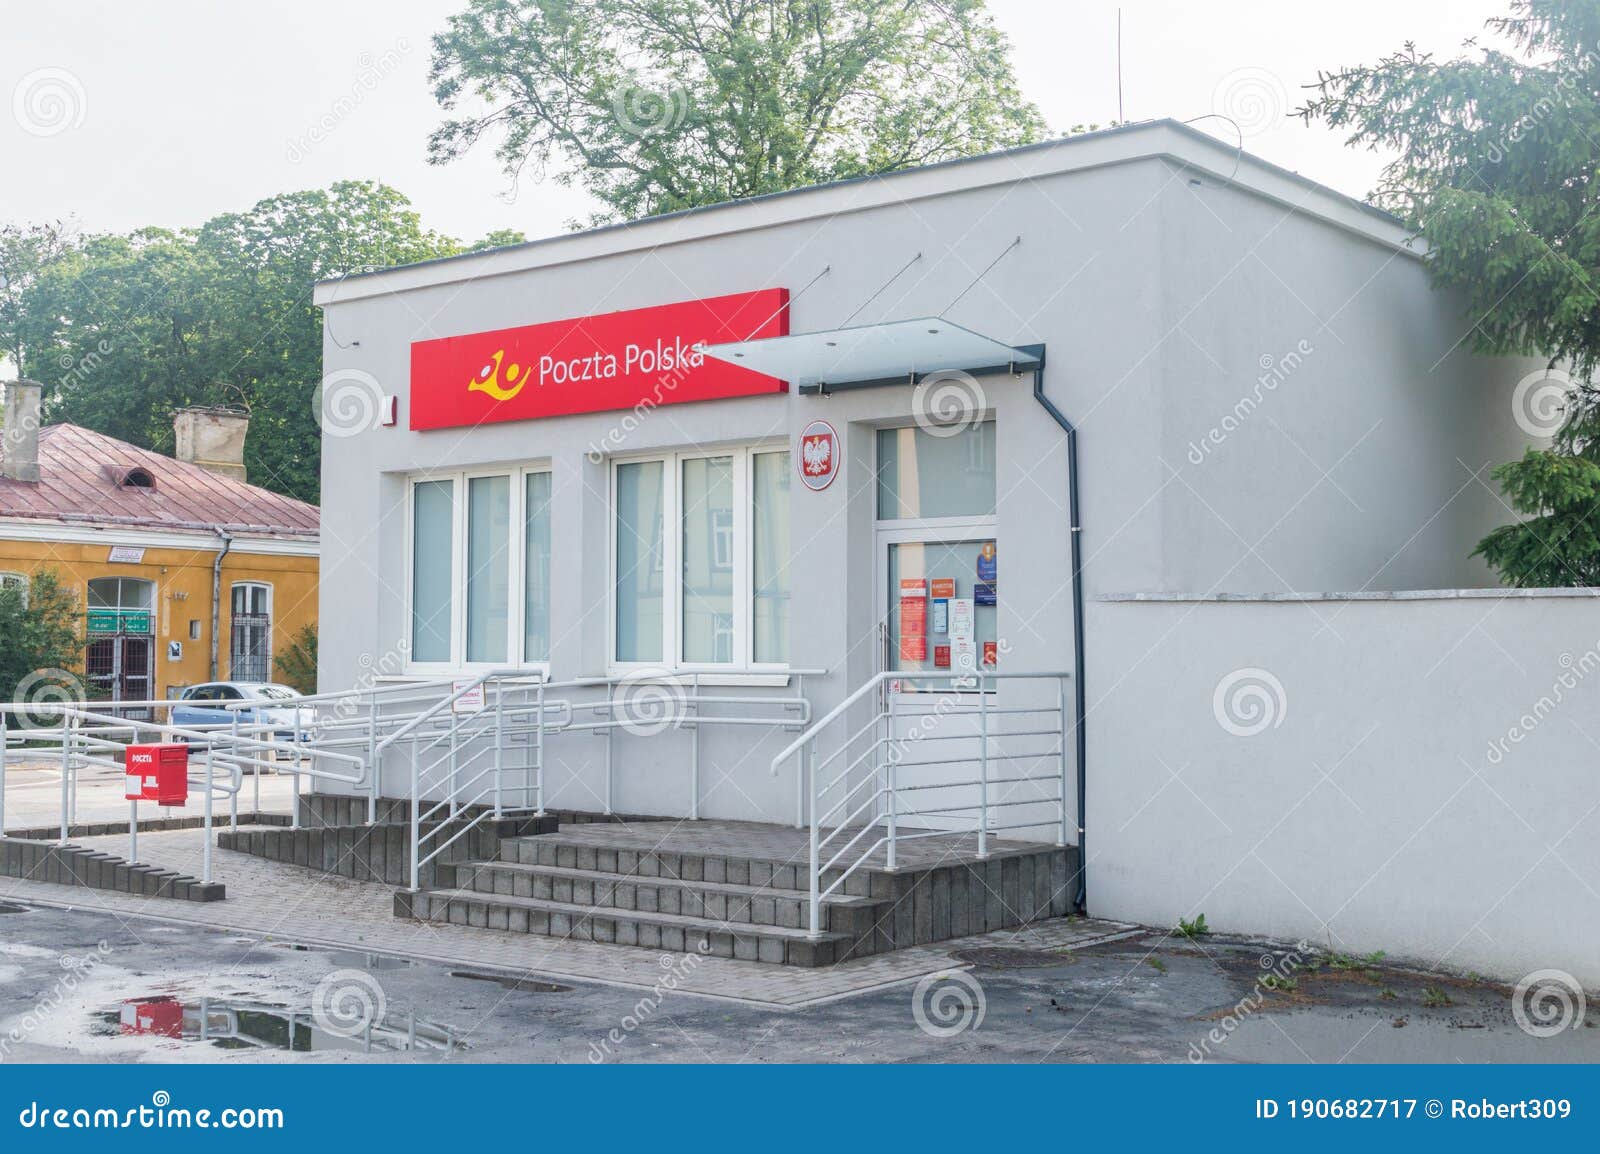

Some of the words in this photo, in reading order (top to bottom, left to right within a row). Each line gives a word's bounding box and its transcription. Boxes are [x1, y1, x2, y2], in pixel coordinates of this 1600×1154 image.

[539, 350, 617, 385] Poczta
[625, 336, 705, 375] Polska
[131, 753, 153, 764] POCZTA
